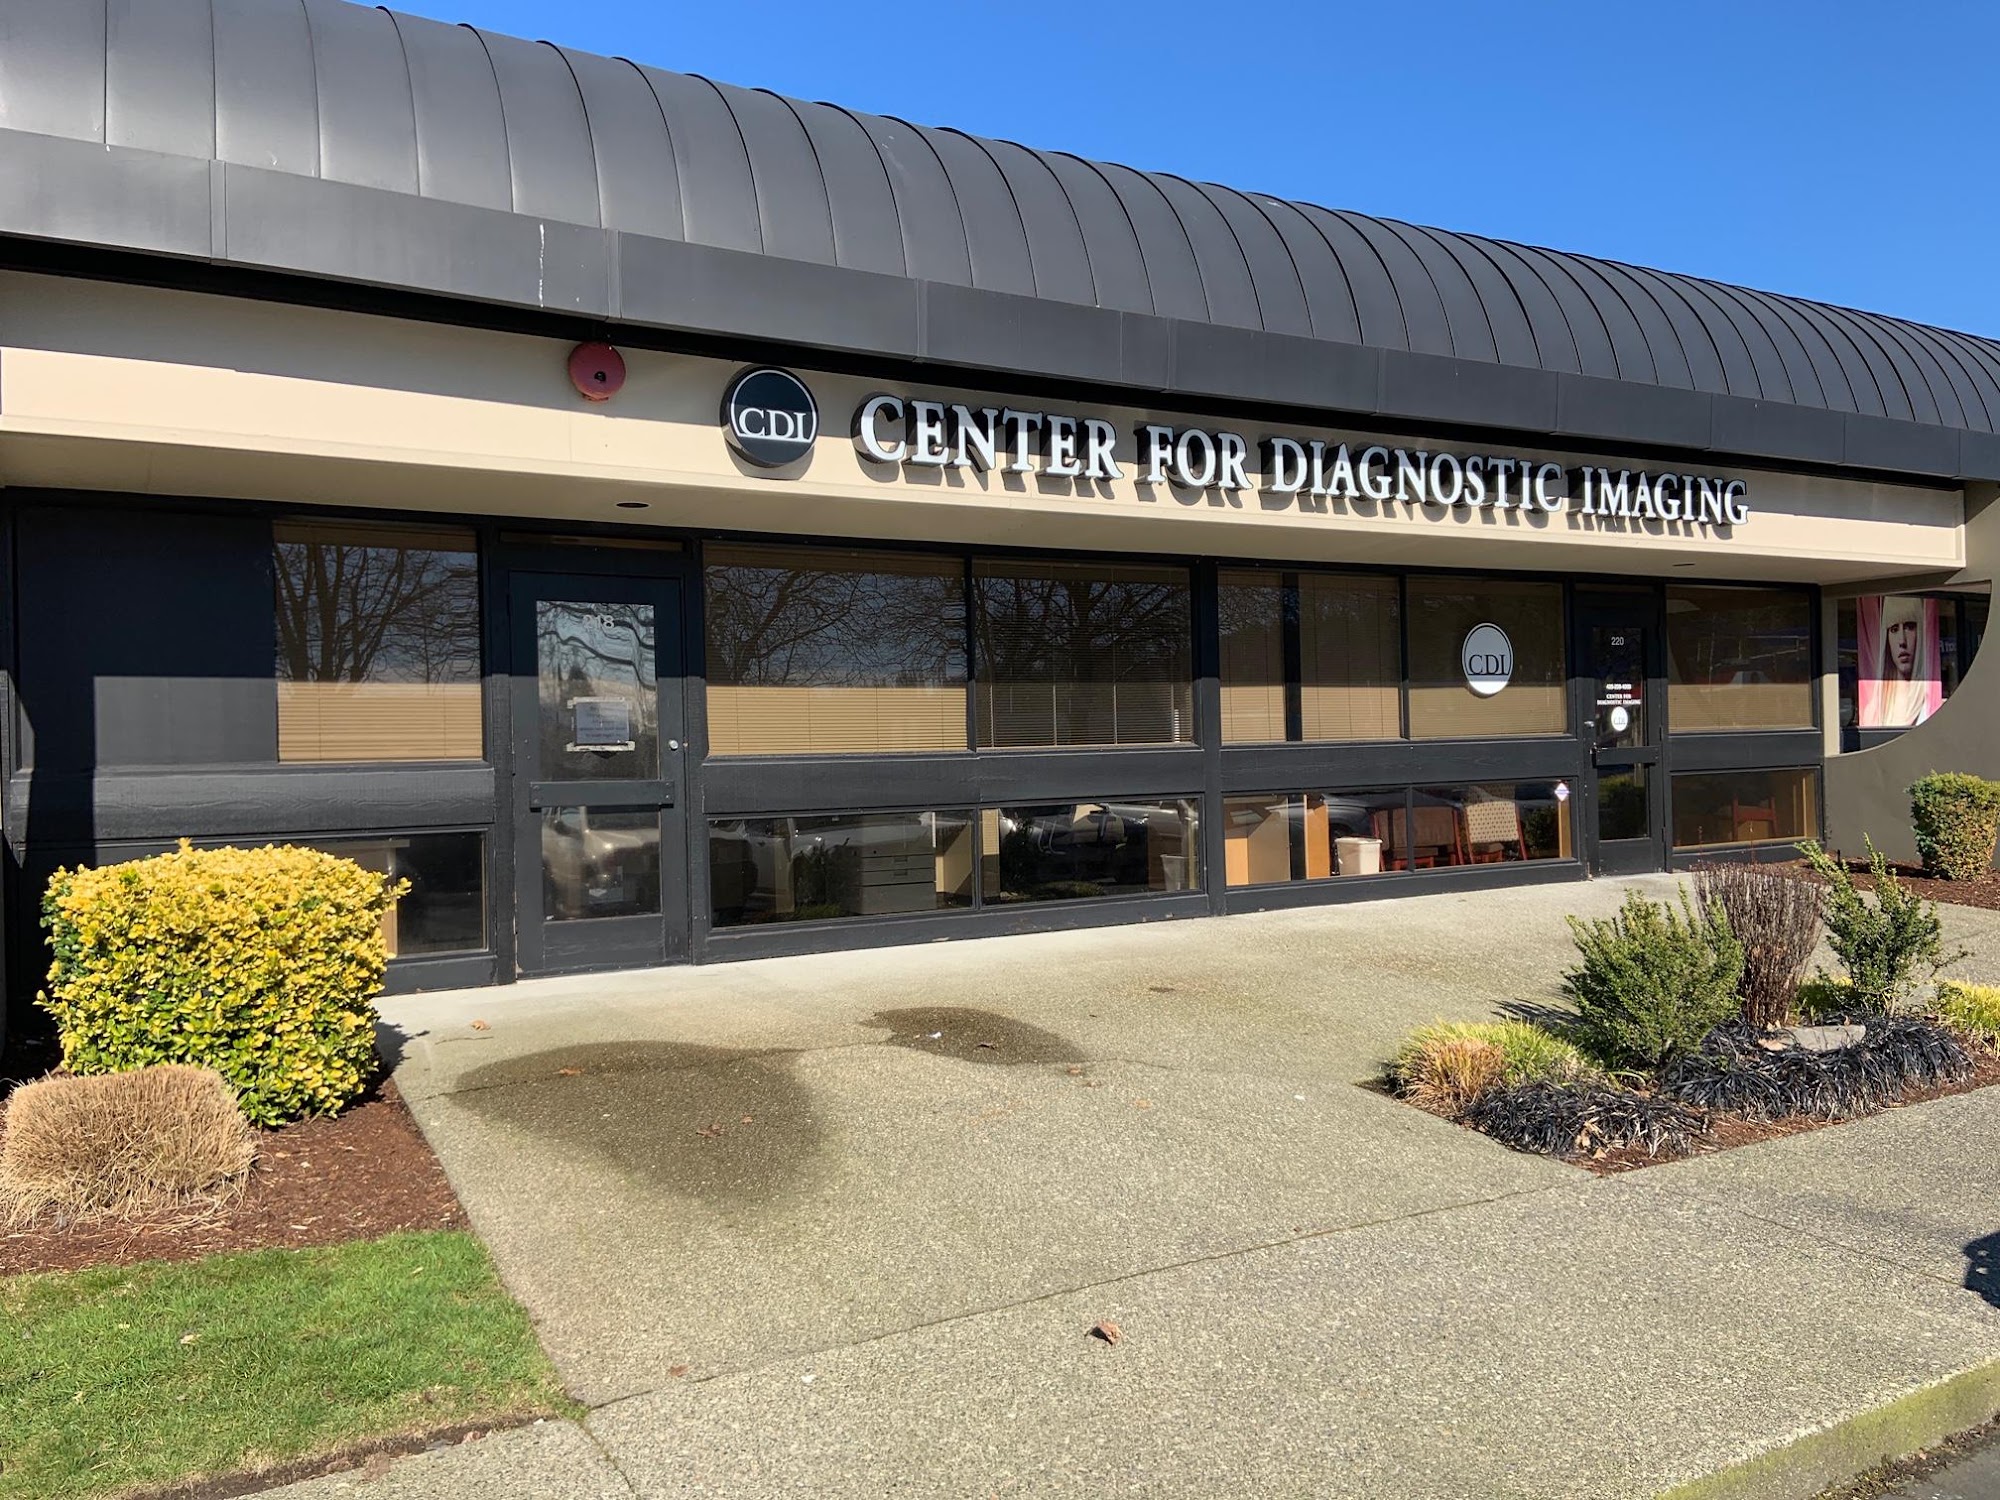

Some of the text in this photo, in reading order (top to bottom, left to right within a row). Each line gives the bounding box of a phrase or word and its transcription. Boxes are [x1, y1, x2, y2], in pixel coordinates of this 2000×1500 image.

[739, 407, 807, 440] CDI
[860, 395, 1748, 525] CENTER FOR DIAGNOSTIC IMAGING
[582, 614, 614, 628] 218
[1611, 636, 1624, 646] 220
[1468, 654, 1506, 675] CDI
